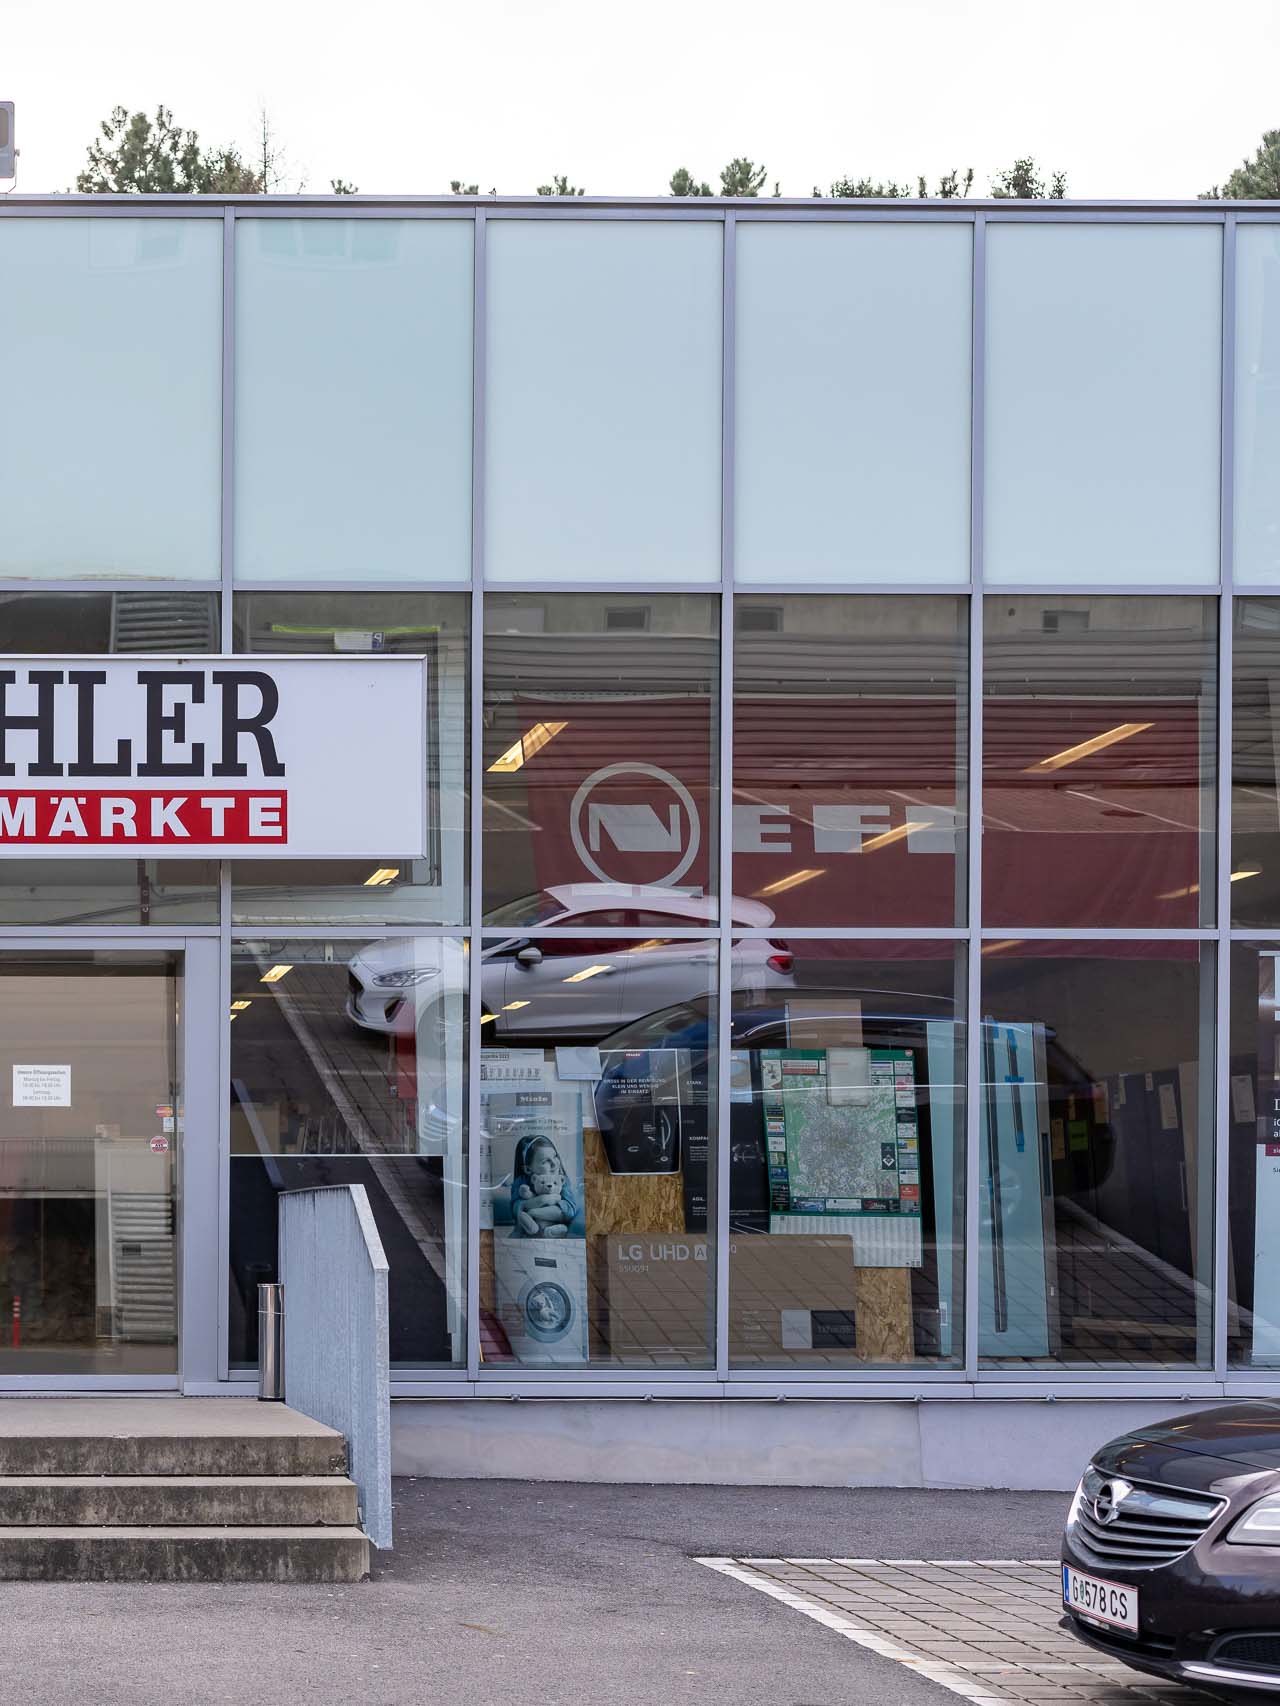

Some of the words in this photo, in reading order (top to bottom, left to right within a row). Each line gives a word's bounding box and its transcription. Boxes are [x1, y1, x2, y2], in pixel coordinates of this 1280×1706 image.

[618, 1244, 643, 1261] LG
[650, 1244, 690, 1261] UHD
[1110, 1589, 1128, 1620] CS
